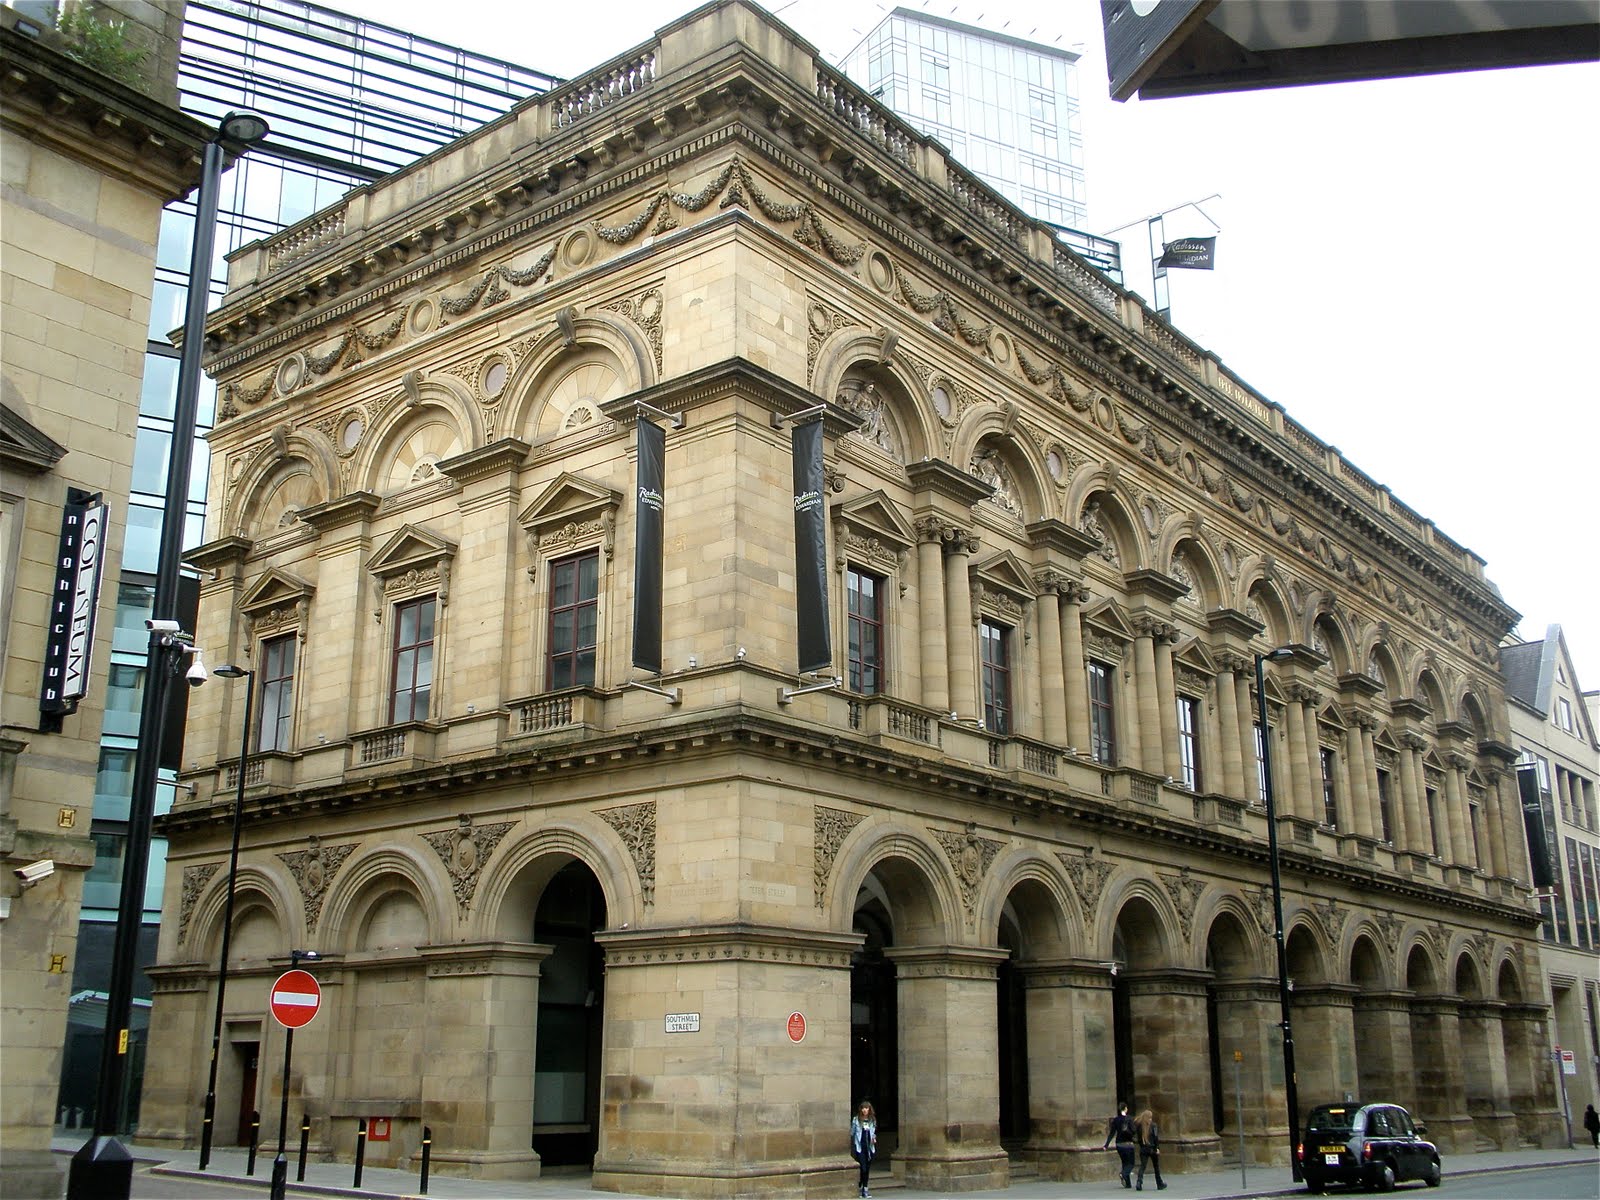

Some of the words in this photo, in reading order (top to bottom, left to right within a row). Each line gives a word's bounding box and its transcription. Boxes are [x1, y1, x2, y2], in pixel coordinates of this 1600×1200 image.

[66, 518, 98, 682] COLISEUM
[666, 1015, 698, 1023] SOUTHMILL
[671, 1023, 692, 1031] STREET
